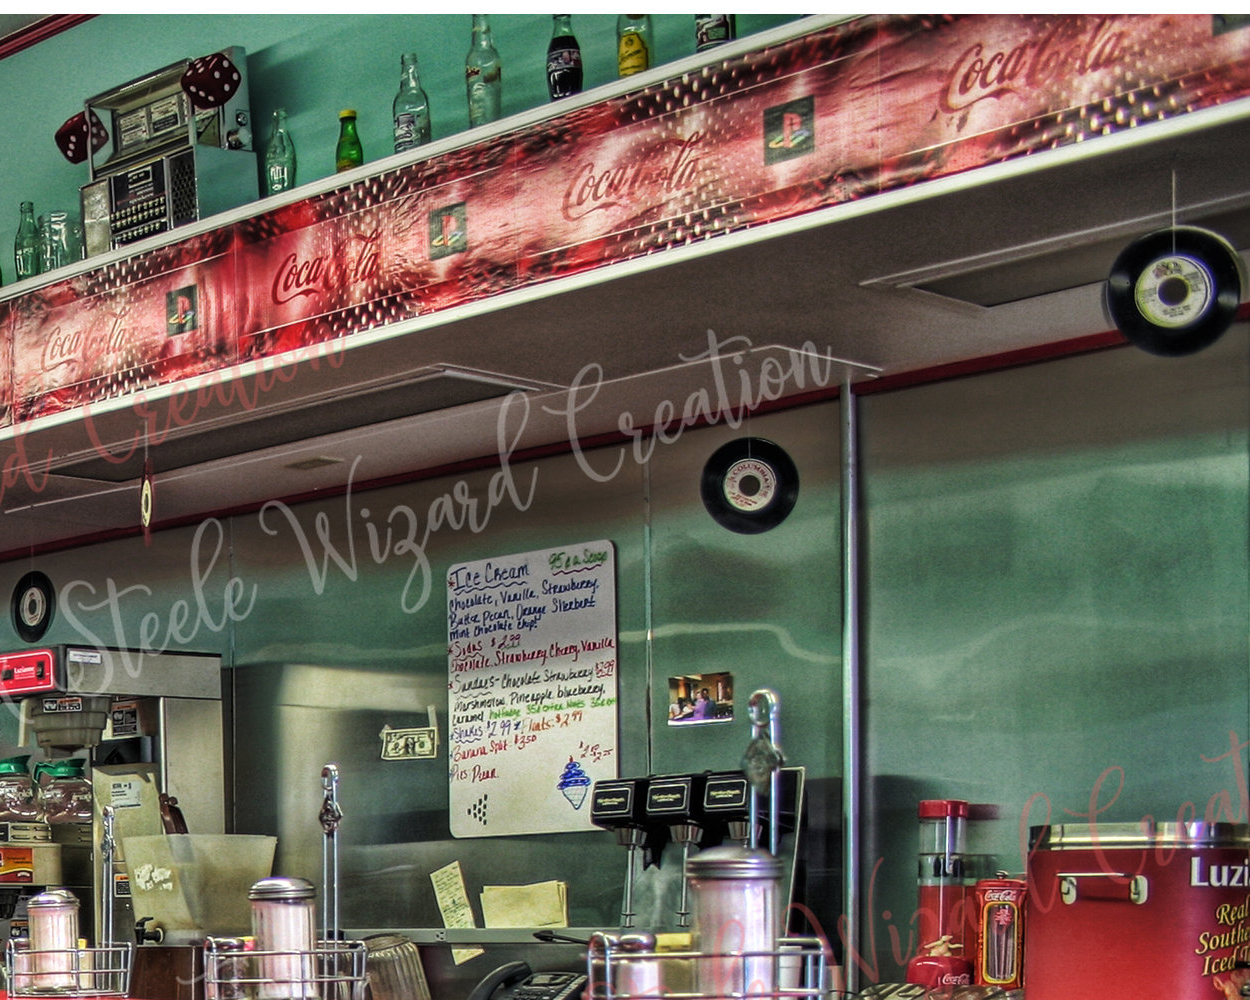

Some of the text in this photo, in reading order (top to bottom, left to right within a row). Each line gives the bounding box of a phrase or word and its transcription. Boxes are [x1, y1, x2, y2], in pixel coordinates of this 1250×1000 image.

[450, 566, 481, 591] Ice
[1190, 856, 1250, 887] Luzi
[1216, 894, 1250, 926] Real
[1201, 945, 1240, 977] Iced
